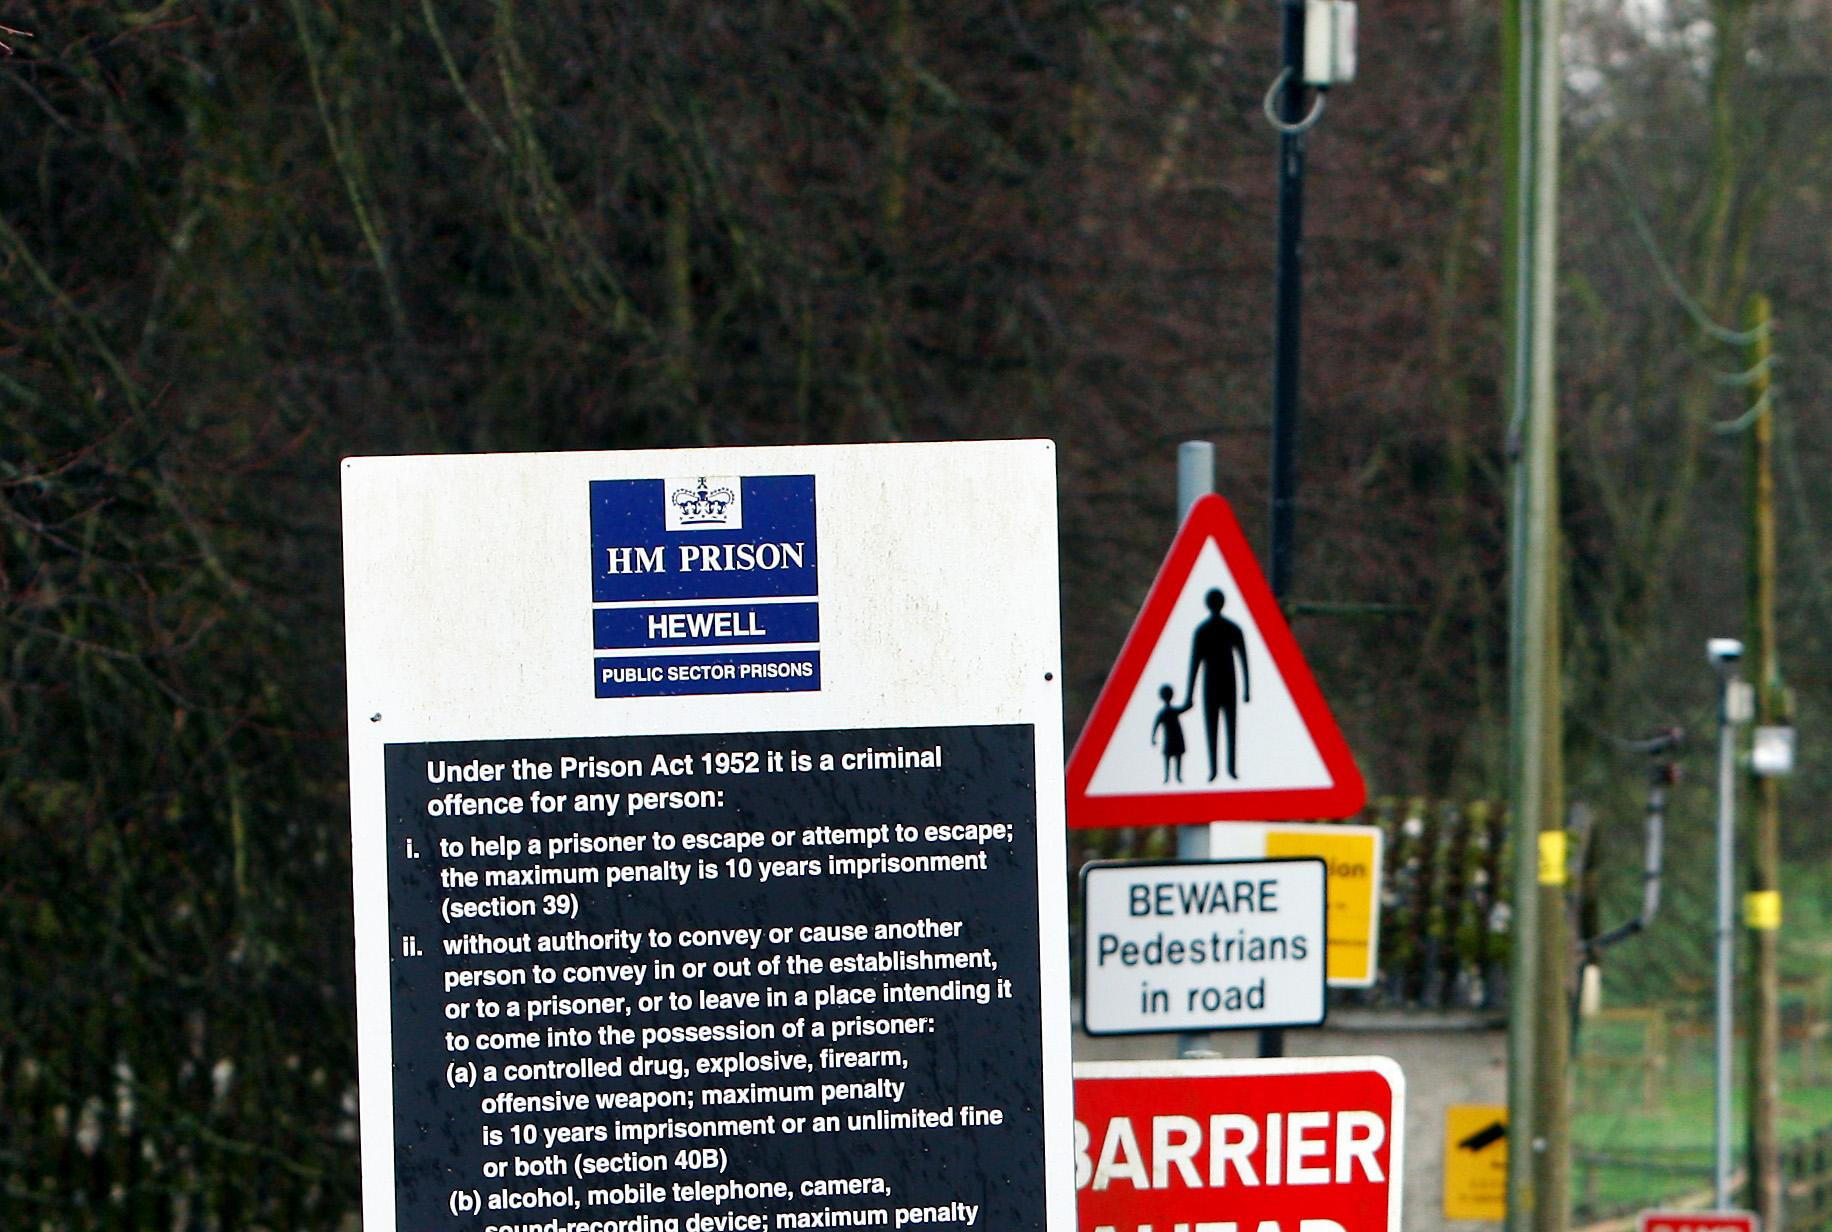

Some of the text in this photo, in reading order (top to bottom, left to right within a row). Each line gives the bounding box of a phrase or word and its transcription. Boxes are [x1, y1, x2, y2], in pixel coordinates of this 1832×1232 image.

[606, 542, 805, 575] HM PRISON
[648, 611, 766, 639] HEWELL
[602, 662, 813, 683] PUBLIC SECTOR PRISONS
[427, 745, 941, 783] Under the Prison Act 1952 it is a criminal
[427, 790, 723, 817] offence for any person:
[406, 823, 1013, 860] i. to help a prisoner to escape or attempt to escape;
[440, 850, 987, 887] the maximum penalty is 10 years imprisonment
[441, 893, 578, 923] (section 39)
[1129, 879, 1279, 917] BEWARE
[402, 917, 963, 956] ii. without authority to convey or cause another
[1098, 929, 1307, 967] Pedestrians
[444, 948, 997, 992] person to convey in or out of the establishment,
[1141, 977, 1266, 1014] in road
[444, 1015, 934, 1051] to come into the possession of a prisoner:
[446, 1048, 908, 1088] (a) a controlled drug, explosive, firearm,
[482, 1105, 1003, 1148] is 10 years imprisonment or an unlimited fine
[449, 1177, 891, 1216] (b) alcohol, mobile telephone, camera,
